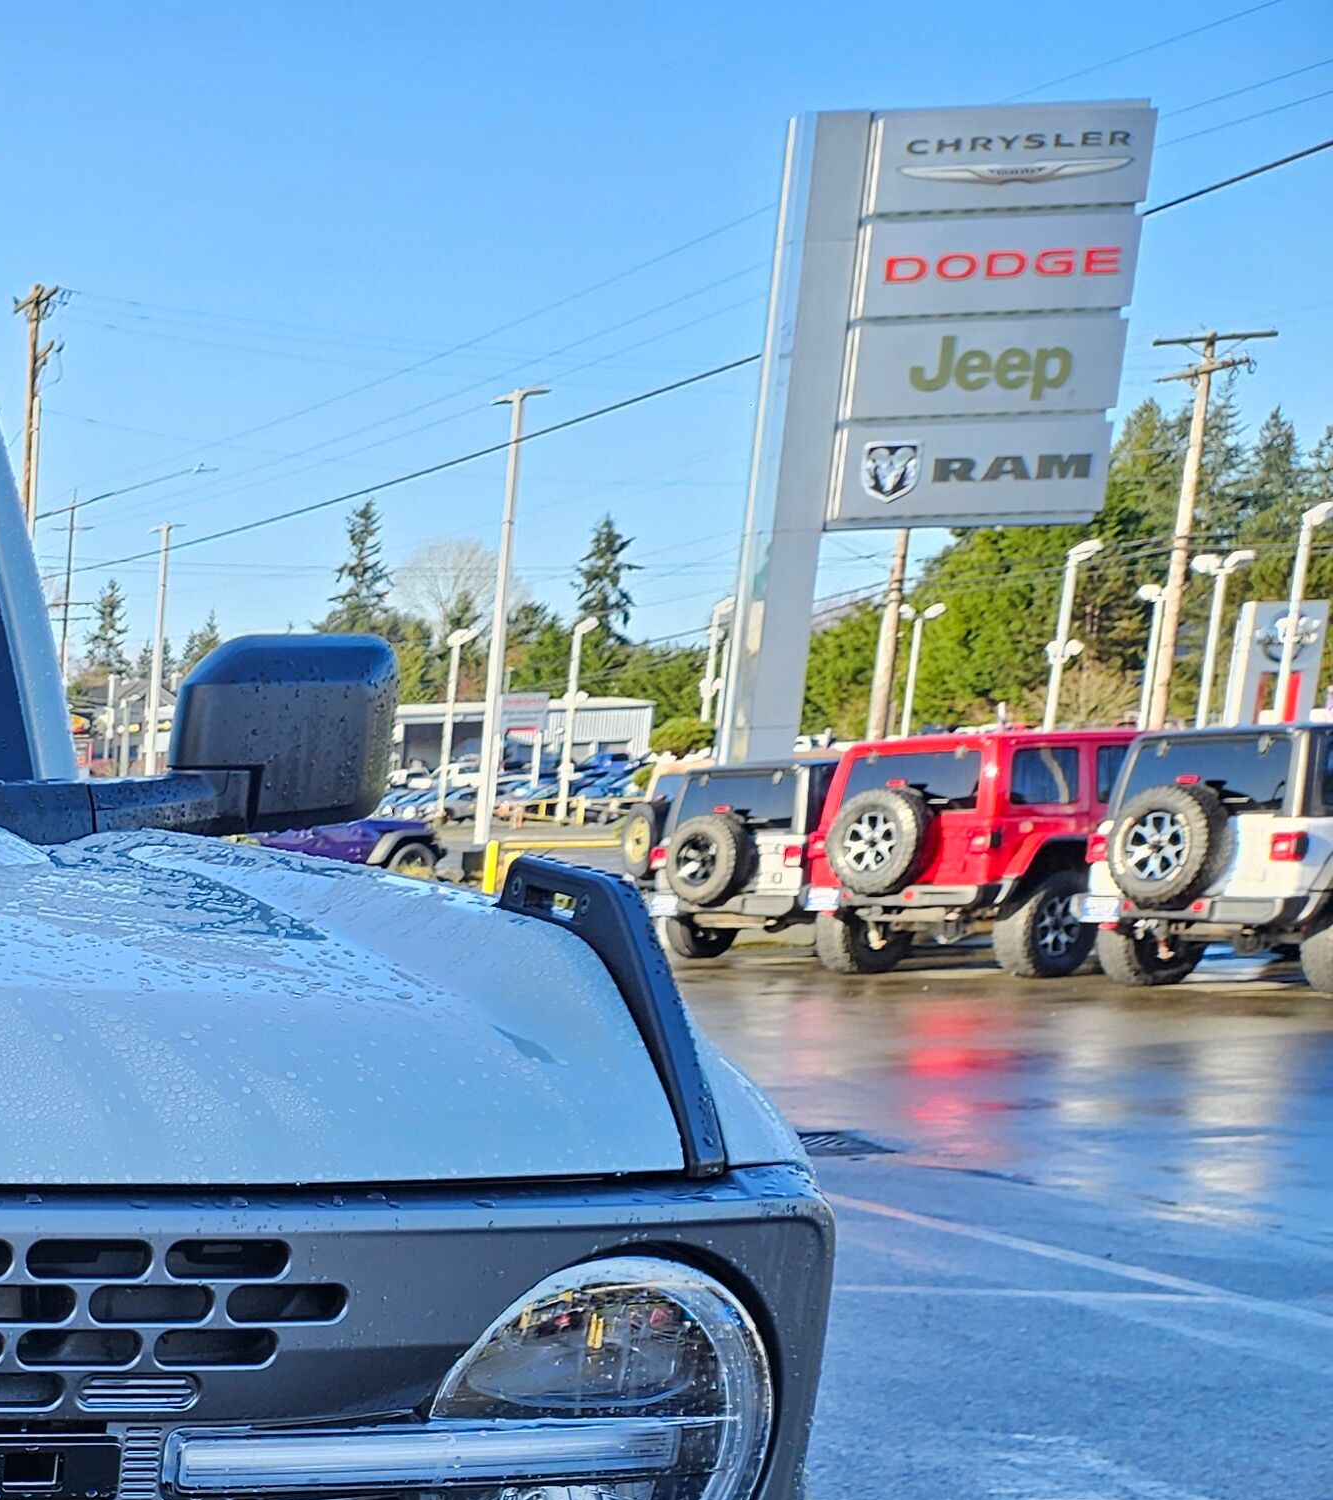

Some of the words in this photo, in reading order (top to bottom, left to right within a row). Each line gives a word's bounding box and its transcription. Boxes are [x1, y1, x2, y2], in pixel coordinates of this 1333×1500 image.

[906, 131, 1131, 155] CHRYSLER
[884, 247, 1122, 283] DODGE
[909, 335, 1072, 400] Jeep
[932, 453, 1093, 483] RAM
